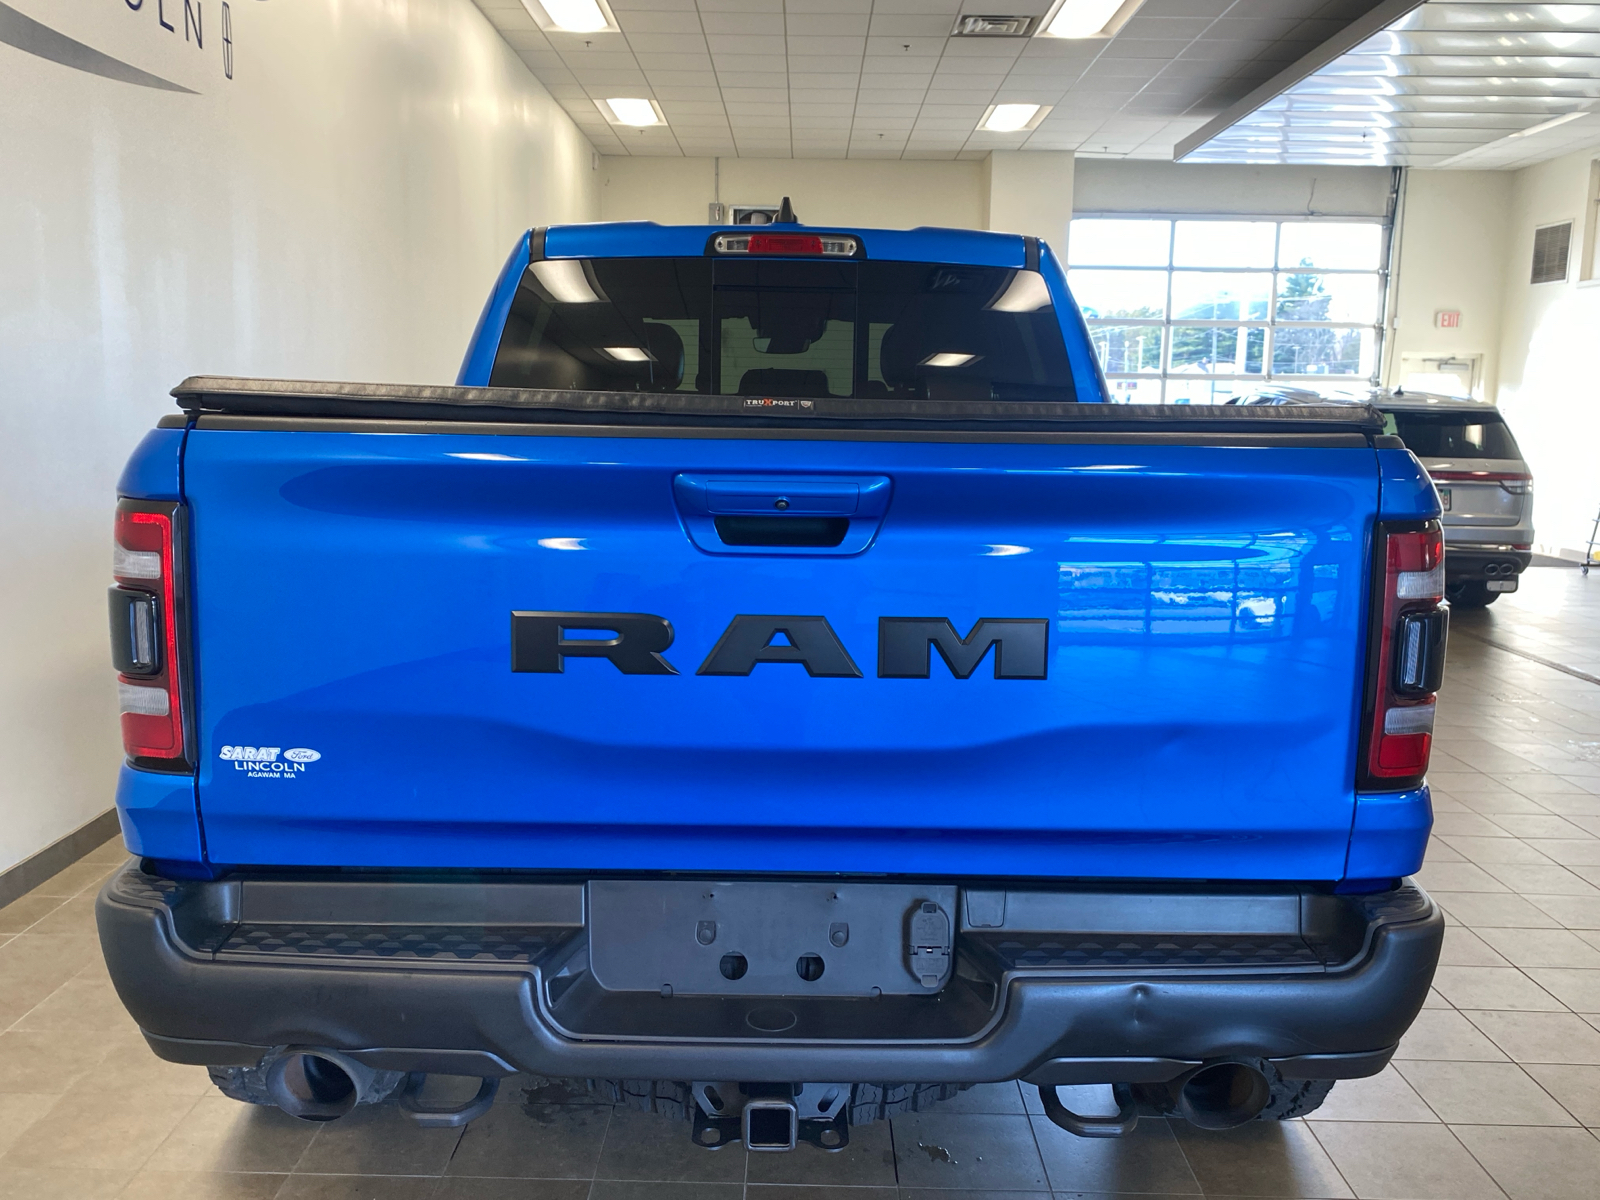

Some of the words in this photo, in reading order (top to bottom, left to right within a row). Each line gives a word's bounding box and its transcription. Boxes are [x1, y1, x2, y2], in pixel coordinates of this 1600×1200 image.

[125, 0, 202, 49] LN
[1441, 311, 1460, 327] EXIT
[746, 398, 795, 406] TRUXPORT
[511, 610, 1049, 680] RAM
[219, 746, 280, 761] SARAT
[290, 750, 315, 760] Ford
[235, 761, 305, 771] LINCOLN
